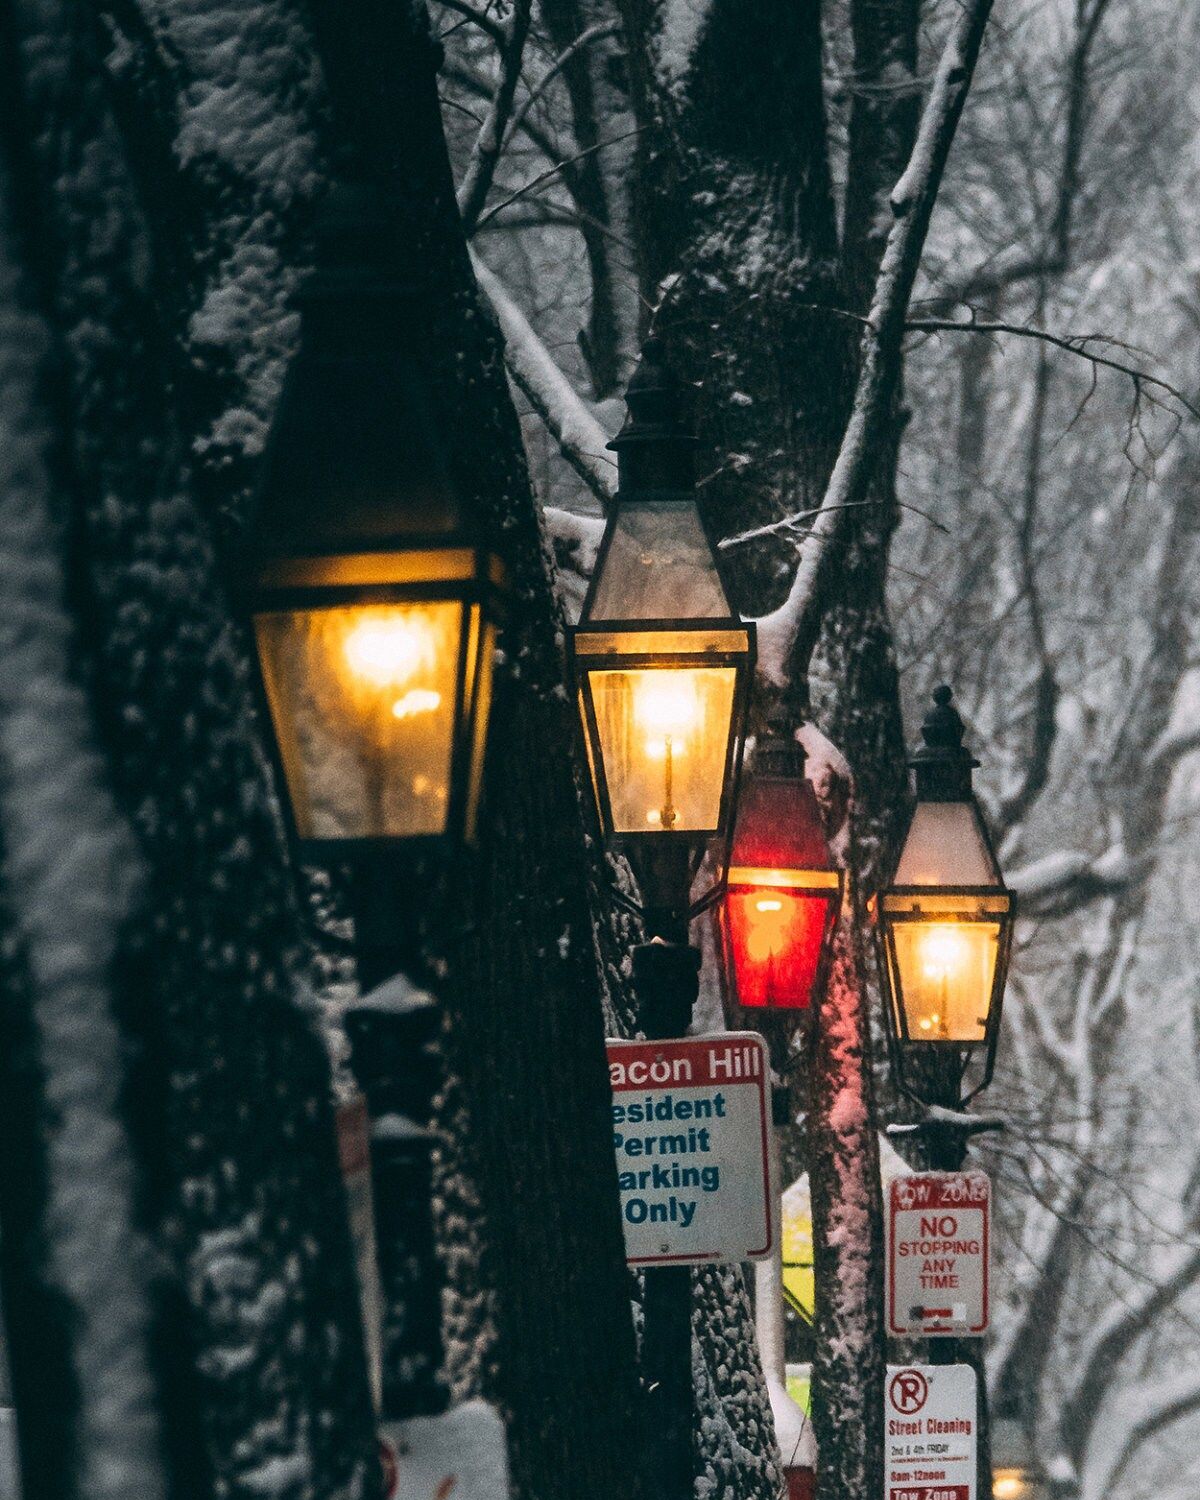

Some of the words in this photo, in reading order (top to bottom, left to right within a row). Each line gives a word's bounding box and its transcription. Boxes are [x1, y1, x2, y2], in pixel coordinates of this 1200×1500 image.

[608, 1056, 692, 1086] acon
[708, 1046, 761, 1079] Hill
[611, 1092, 726, 1124] esident
[619, 1162, 720, 1192] arking
[625, 1196, 697, 1228] Only
[919, 1216, 958, 1238] NO
[898, 1240, 980, 1257] STOPPING
[921, 1259, 956, 1273] ANY
[919, 1275, 960, 1289] TIME
[888, 1418, 923, 1436] Street
[926, 1417, 972, 1436] Cleaning
